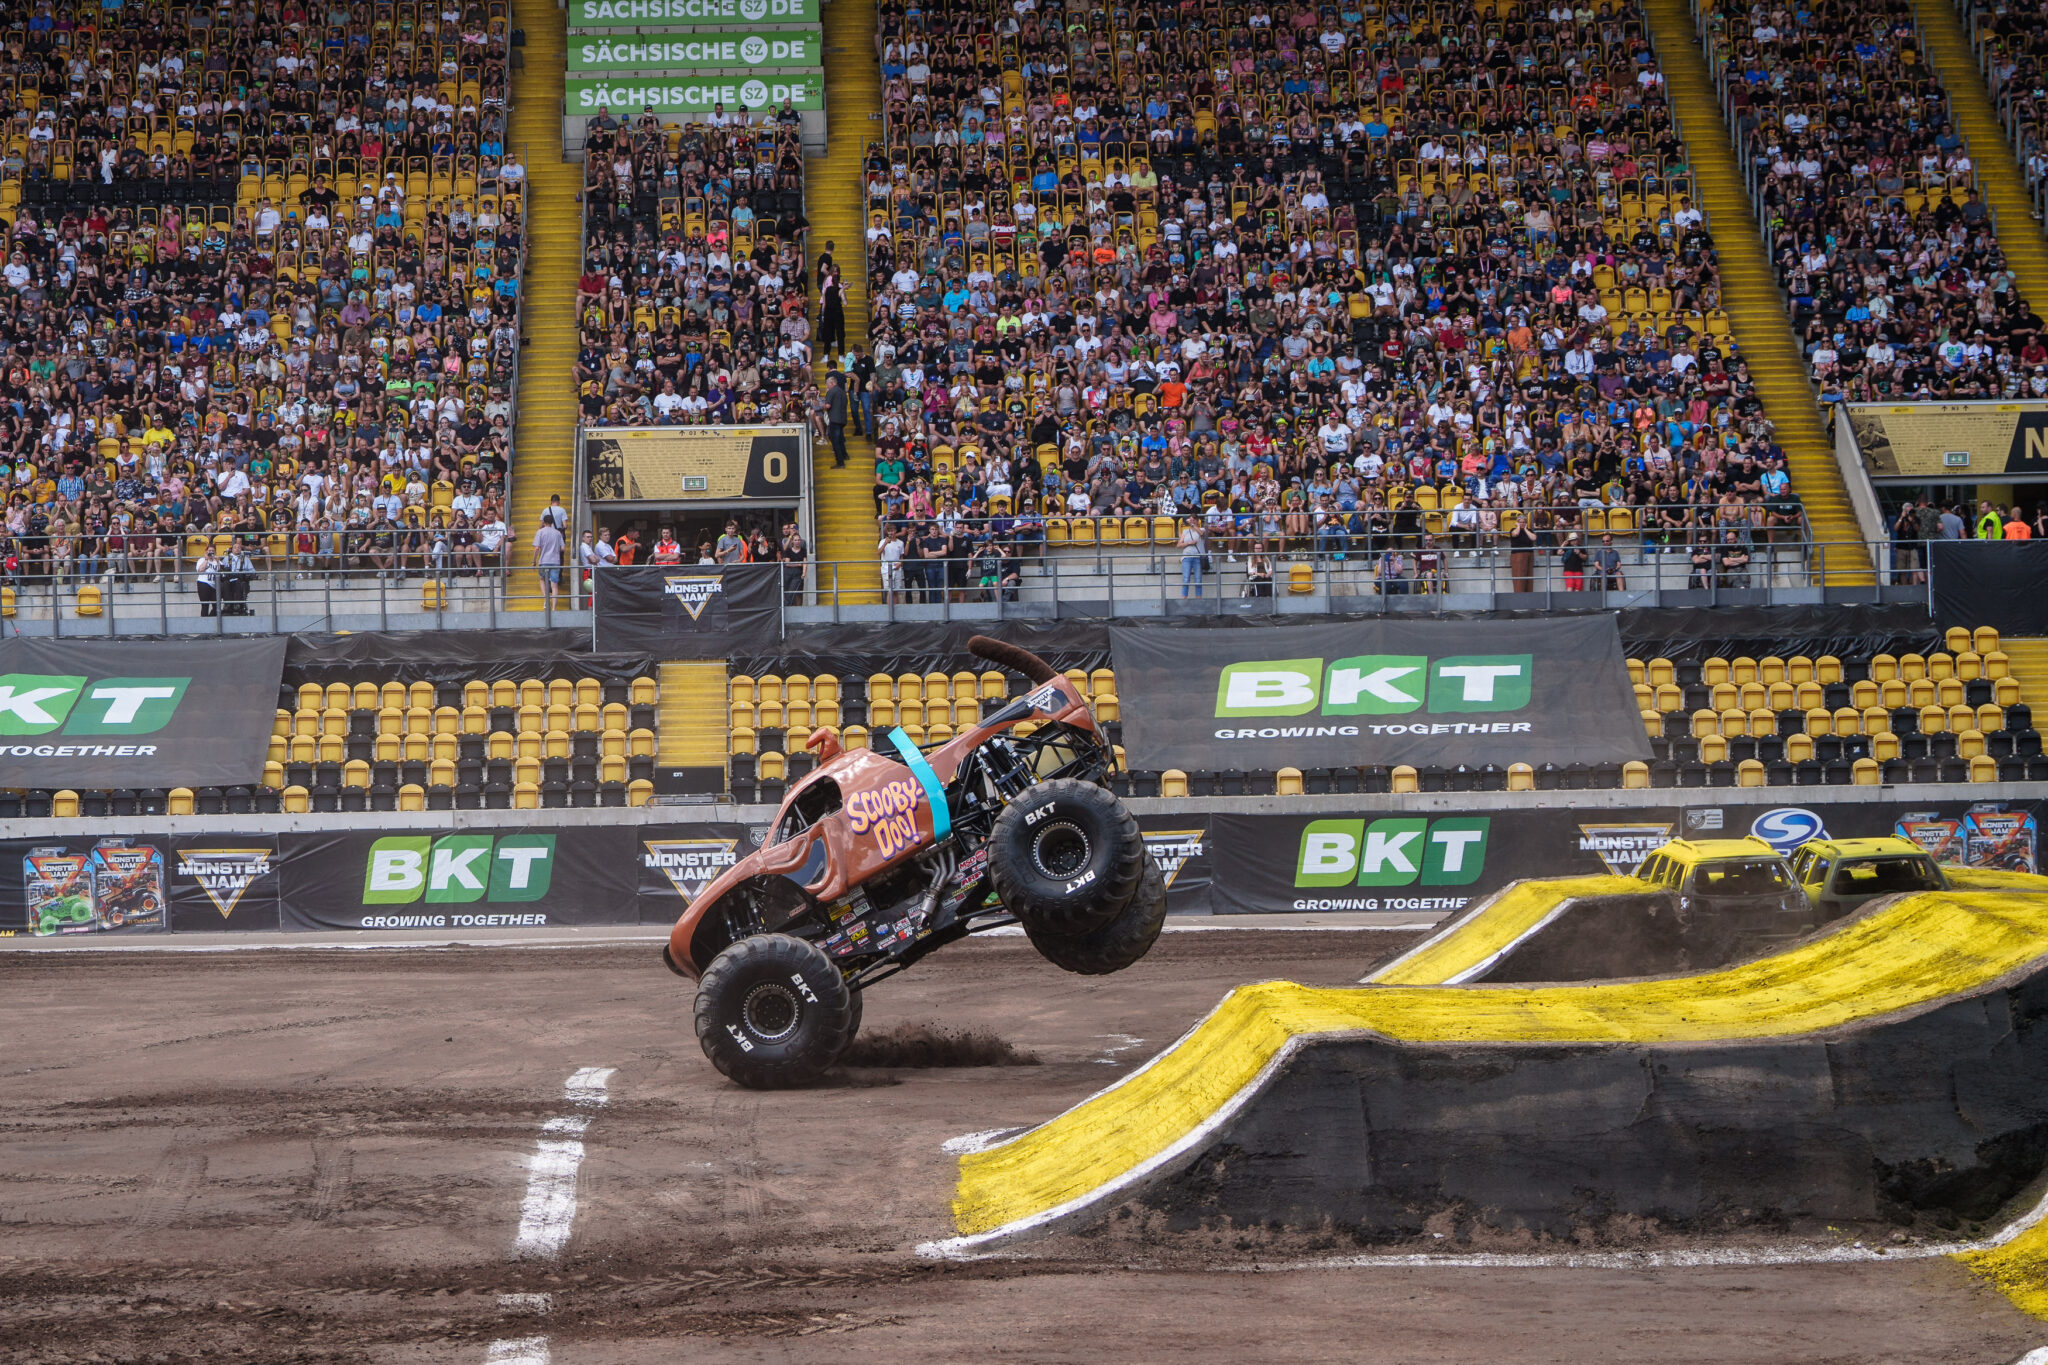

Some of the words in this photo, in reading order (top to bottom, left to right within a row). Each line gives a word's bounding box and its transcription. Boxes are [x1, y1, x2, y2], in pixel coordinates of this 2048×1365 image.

[772, 0, 804, 15] DE
[582, 39, 736, 63] SÄCHSISCHE
[745, 43, 763, 56] SZ
[772, 40, 805, 59] DE
[579, 83, 736, 107] SÄCHSISCHE
[744, 87, 763, 100] SZ
[772, 84, 805, 102] DE
[665, 583, 722, 594] MONSTER
[680, 594, 707, 602] JAM
[1226, 665, 1521, 708] BKT
[1214, 725, 1359, 740] GROWING
[1368, 722, 1532, 736] TOGETHER
[0, 745, 157, 757] TOGETHER
[1024, 801, 1056, 826] BKT
[645, 851, 737, 867] MONSTER
[1302, 830, 1483, 874] BKT
[178, 861, 271, 875] MONSTER
[369, 847, 548, 891] BKT
[671, 867, 714, 881] JAM
[204, 875, 245, 888] JAM
[1065, 869, 1096, 895] BKT
[1293, 898, 1379, 910] GROWING
[1383, 897, 1472, 910] TOGETHE
[361, 915, 446, 928] GROWING
[451, 914, 547, 926] TOGETHER
[790, 973, 819, 1004] BKT
[726, 1024, 754, 1053] BKT
